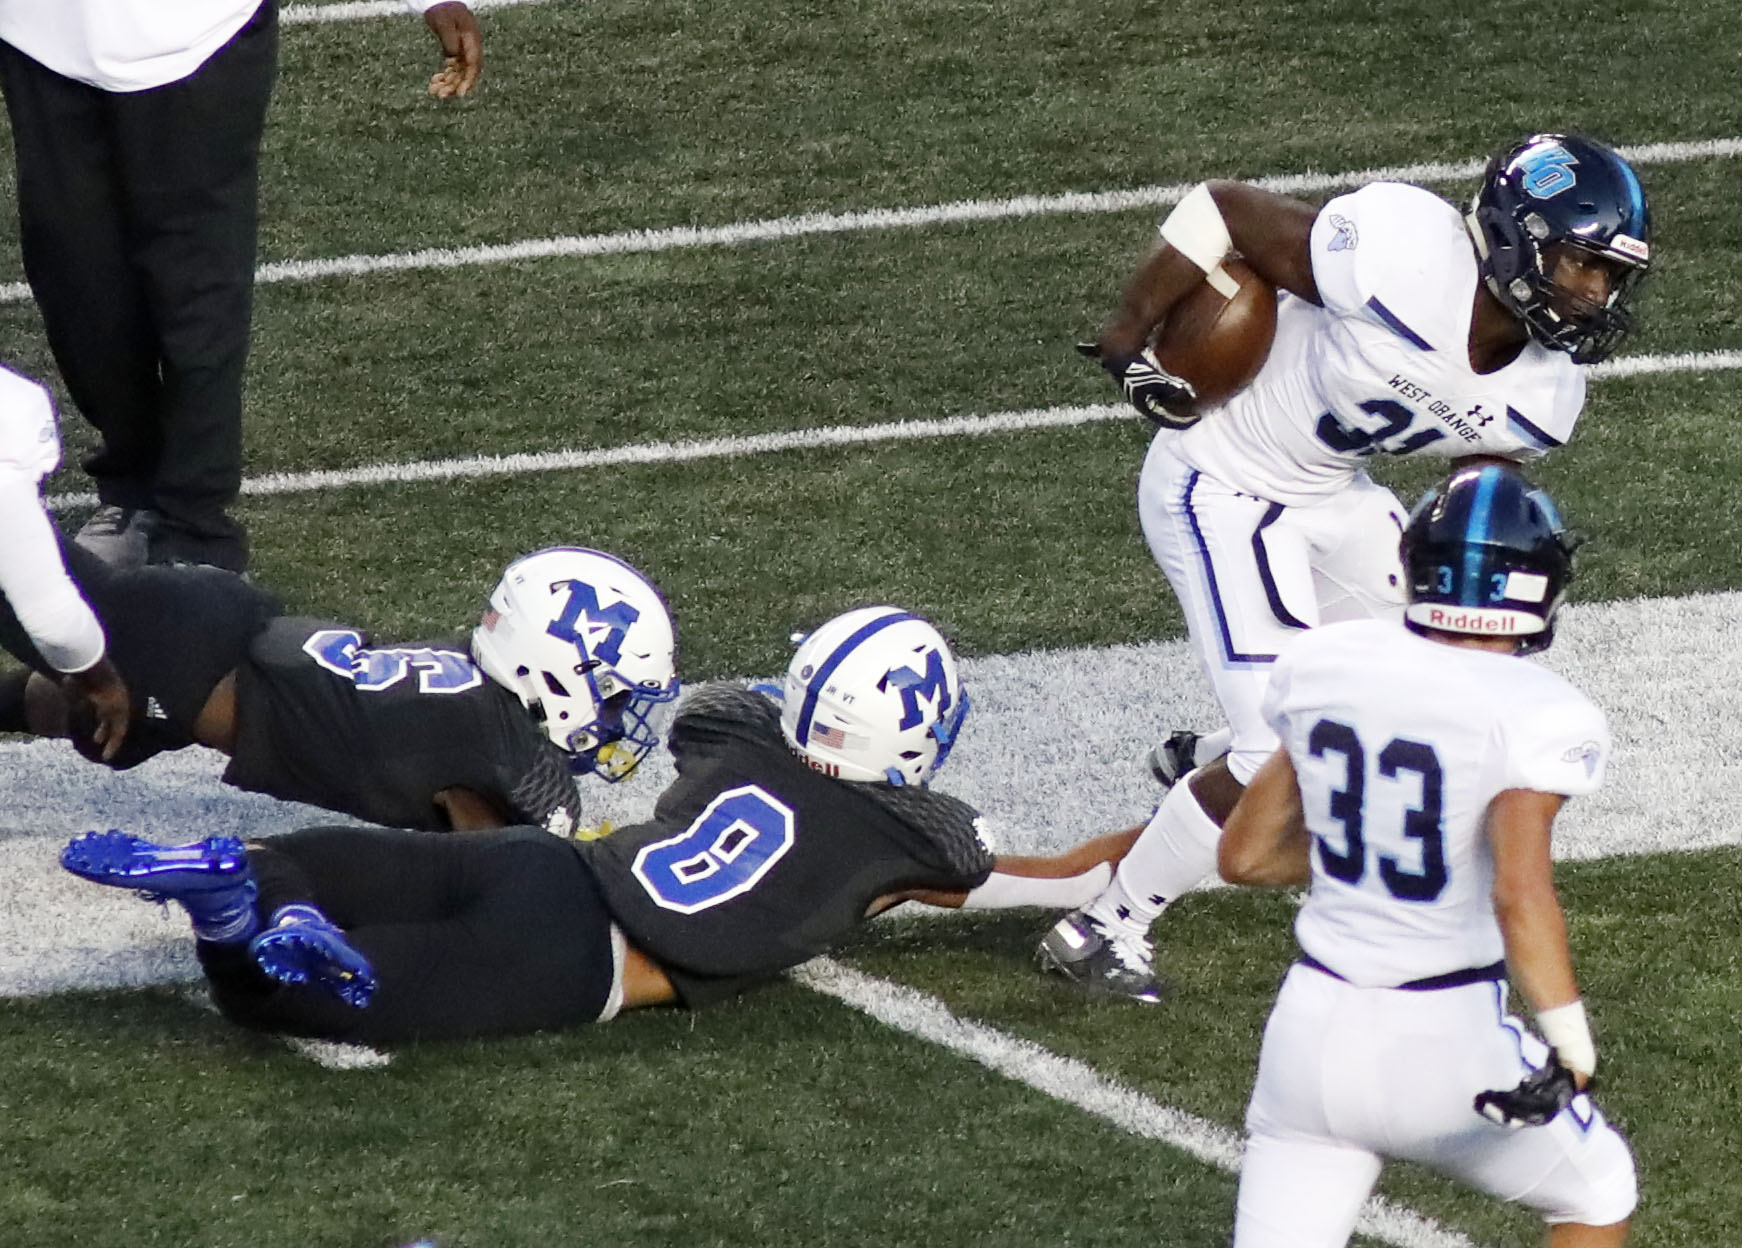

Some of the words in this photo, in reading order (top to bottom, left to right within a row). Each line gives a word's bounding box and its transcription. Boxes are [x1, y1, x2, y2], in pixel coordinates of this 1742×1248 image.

[1388, 373, 1431, 404] WEST
[1428, 400, 1482, 444] ORANGE
[547, 578, 640, 667] M
[1429, 608, 1516, 633] Riddell
[1437, 565, 1453, 595] 3
[876, 647, 953, 733] M
[631, 783, 795, 916] 8
[1308, 718, 1448, 902] 33
